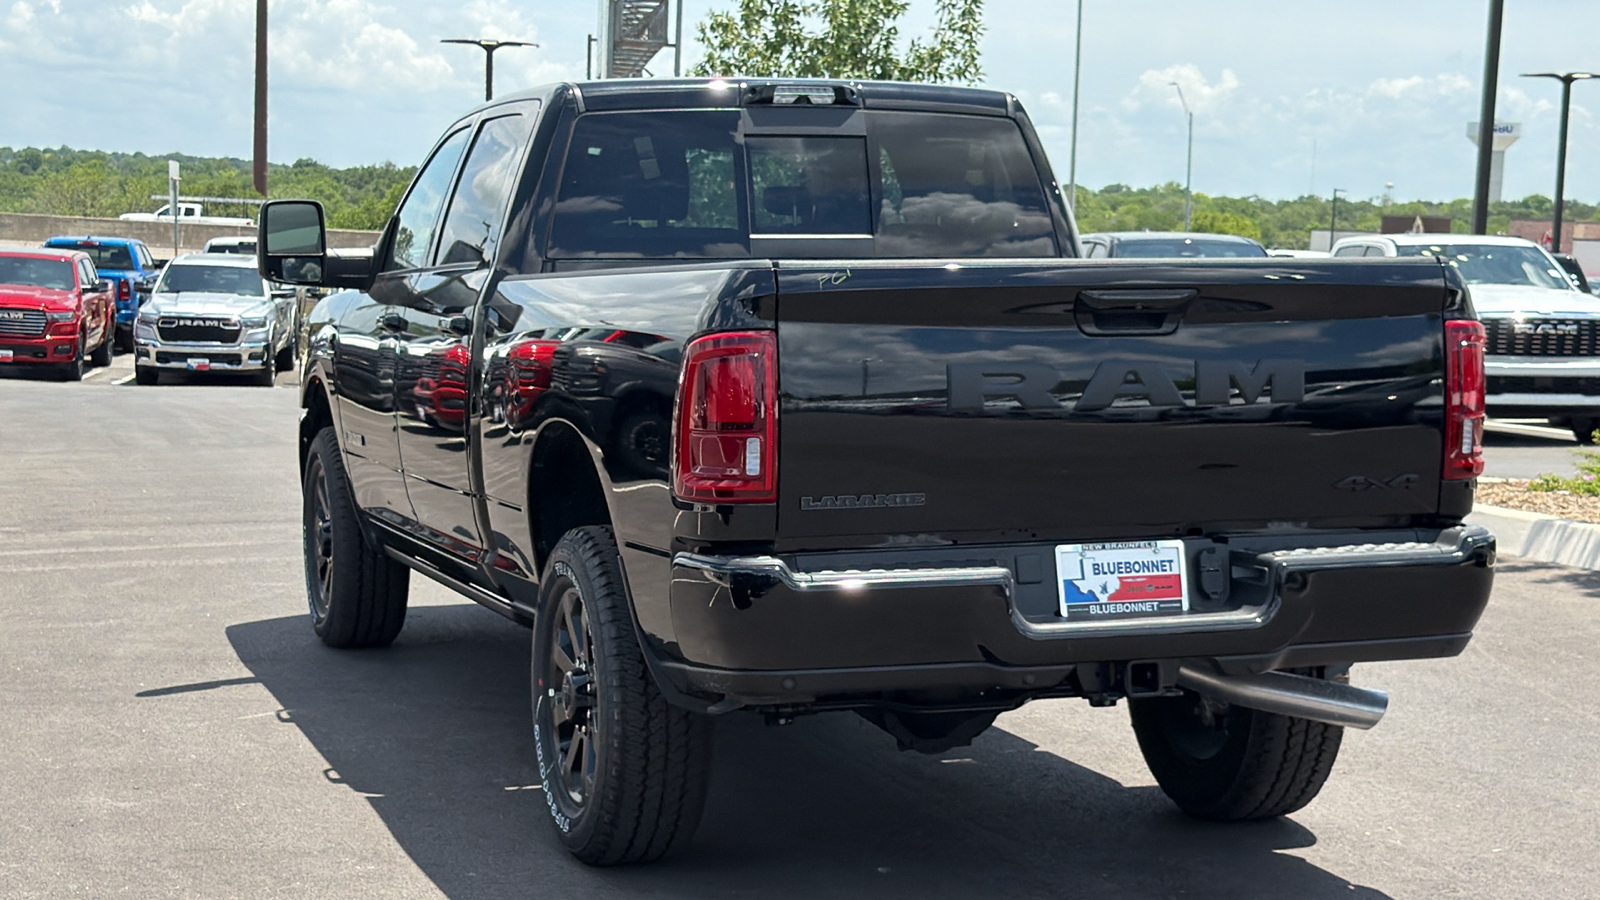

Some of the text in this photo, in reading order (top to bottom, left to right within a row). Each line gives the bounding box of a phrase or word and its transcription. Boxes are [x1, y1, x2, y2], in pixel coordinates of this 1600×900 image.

[179, 319, 218, 327] RAM
[1514, 323, 1578, 335] RAM
[946, 358, 1306, 412] RAM
[800, 493, 926, 511] LARAMIE
[1083, 541, 1158, 551] NEW BRAUNFELS
[1092, 560, 1174, 576] BLUEBONNET
[1089, 602, 1159, 614] BLUEBONNET
